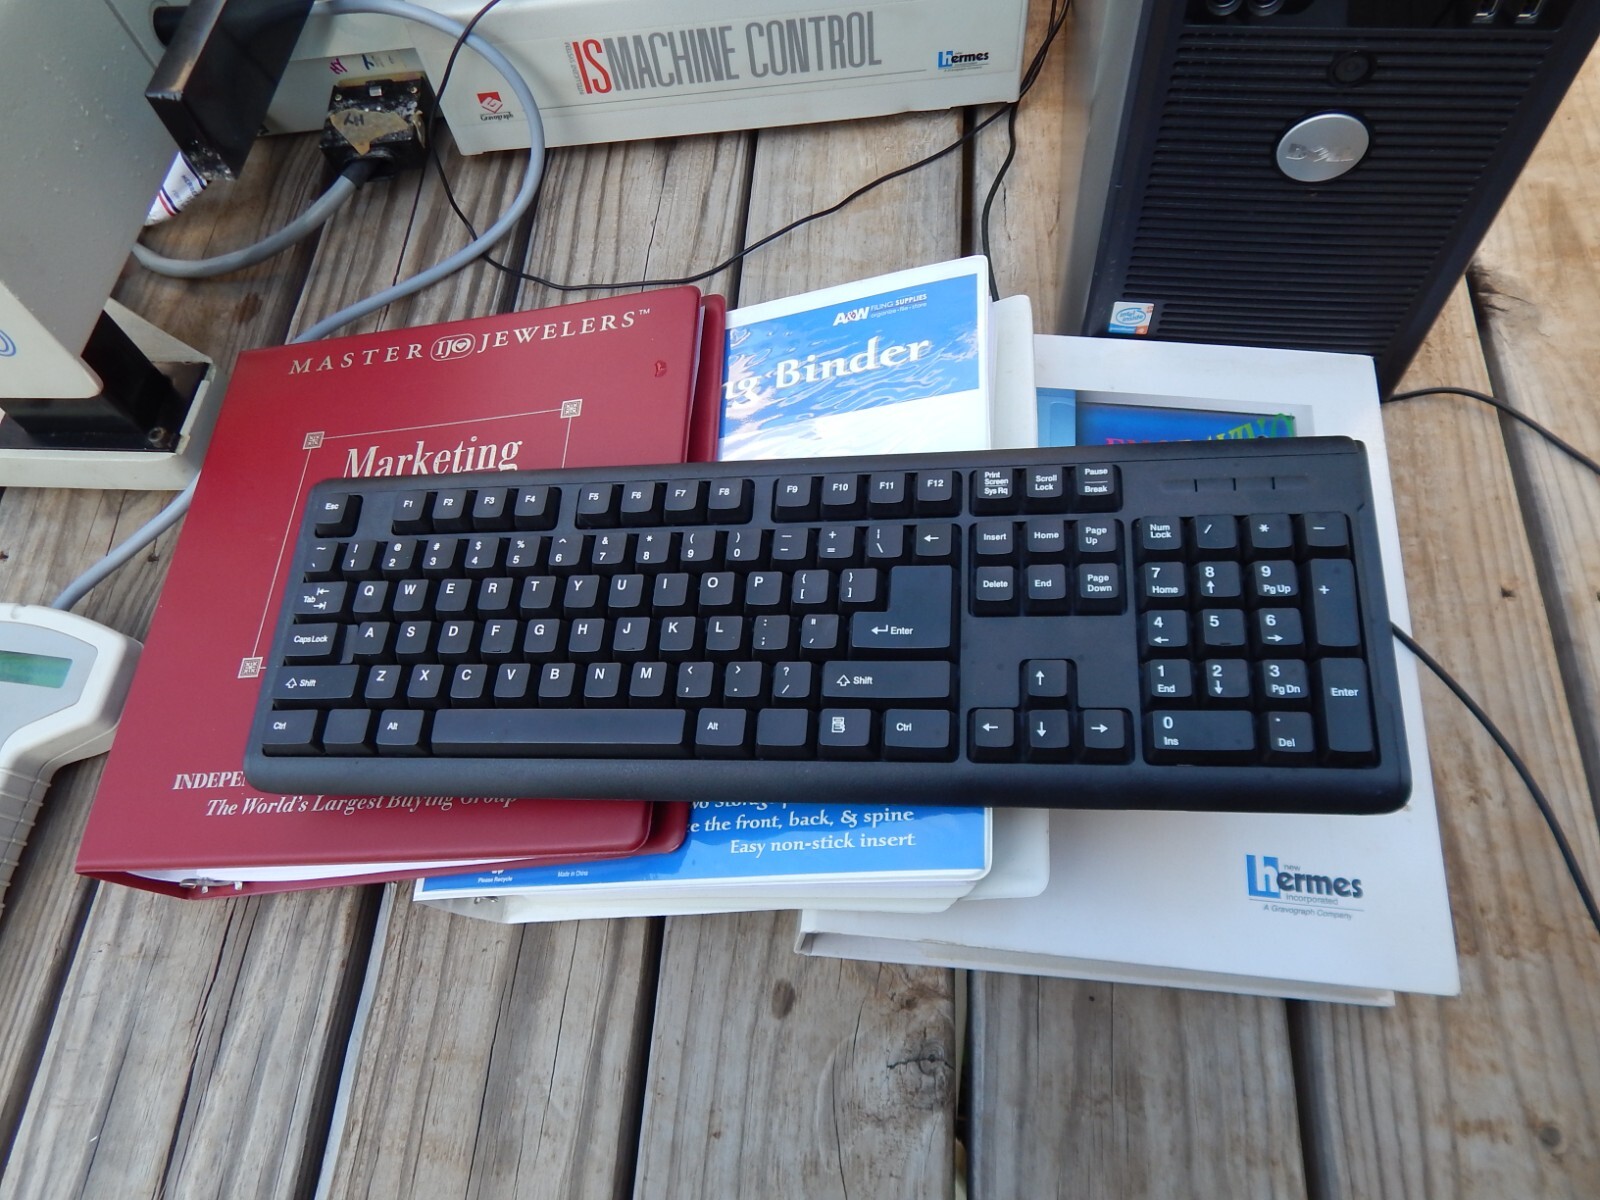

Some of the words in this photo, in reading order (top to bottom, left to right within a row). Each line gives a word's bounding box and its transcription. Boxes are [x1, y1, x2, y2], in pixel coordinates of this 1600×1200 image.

[603, 25, 740, 92] MACHINE
[745, 10, 882, 79] CONTROL
[870, 301, 894, 311] FILING
[895, 293, 928, 306] SUPPLIES
[288, 342, 424, 376] MASTER
[477, 311, 635, 354] JEWELERS
[775, 335, 931, 389] Binder
[343, 435, 523, 479] Marketing
[1084, 468, 1109, 476] Pause
[927, 479, 944, 488] F12
[1035, 474, 1058, 483] Scroll
[786, 485, 799, 494] F9
[832, 483, 849, 492] F10
[879, 481, 894, 490] F11
[1034, 483, 1054, 491] Lock
[1084, 484, 1108, 493] Break
[588, 492, 600, 501] F5
[630, 491, 642, 500] F6
[674, 489, 687, 497] F7
[718, 487, 730, 496] F8
[403, 499, 414, 508] F1
[442, 498, 454, 506] F2
[483, 496, 496, 505] F3
[524, 494, 536, 503] F4
[324, 502, 340, 510] Esc
[1085, 526, 1108, 537] Page
[1149, 523, 1171, 532] Num
[983, 533, 1007, 541] Insert
[1033, 531, 1060, 539] Home
[1150, 530, 1172, 539] Lock
[555, 553, 563, 563] 6
[599, 551, 607, 561] 7
[642, 551, 650, 561] 8
[687, 548, 695, 559] 9
[350, 558, 356, 568] 1
[388, 558, 396, 567] 2
[429, 556, 437, 566] 3
[471, 556, 479, 565] 4
[512, 554, 521, 565] 5
[1151, 567, 1161, 579] 7
[1204, 565, 1215, 578] 8
[1260, 565, 1272, 578] 9
[754, 576, 764, 588] P
[982, 579, 1009, 588] Delete
[1034, 579, 1052, 588] End
[1087, 573, 1110, 584] Page
[363, 584, 375, 596] Q
[404, 584, 417, 595] W
[445, 582, 456, 594] E
[487, 582, 498, 594] R
[530, 580, 540, 592] T
[574, 580, 583, 591] Y
[617, 579, 627, 591] U
[1087, 584, 1113, 592] Down
[1151, 585, 1179, 594] Home
[1153, 616, 1164, 628] 4
[1209, 615, 1220, 628] 5
[1265, 614, 1277, 627] 6
[364, 626, 374, 638] A
[406, 625, 416, 638] S
[448, 625, 459, 637] D
[490, 624, 501, 636] F
[533, 623, 545, 636] G
[577, 623, 588, 635] H
[622, 622, 632, 634] J
[668, 621, 679, 633] K
[715, 621, 724, 633] L
[890, 626, 914, 635] Enter
[311, 635, 328, 643] Lock
[375, 670, 387, 682] Z
[419, 669, 430, 681] X
[461, 668, 472, 681] C
[507, 668, 517, 681] V
[549, 668, 560, 680] B
[594, 667, 606, 680] N
[640, 667, 653, 679] M
[1157, 664, 1165, 677] 1
[1212, 664, 1223, 677] 2
[1269, 664, 1281, 678] 3
[299, 678, 317, 687] Shift
[852, 675, 873, 685] Shift
[1157, 683, 1176, 693] End
[1330, 687, 1359, 697] Enter
[272, 721, 287, 730] Ctrl
[386, 721, 399, 731] Alt
[706, 721, 719, 731] Alt
[896, 722, 912, 732] Ctrl
[1163, 736, 1180, 746] Ins
[1277, 737, 1296, 748] Del
[205, 799, 238, 817] The
[241, 795, 309, 815] World's
[311, 794, 384, 816] Largest
[704, 816, 731, 832] the
[735, 813, 782, 830] front,
[789, 807, 834, 827] back,
[840, 810, 858, 828] &
[863, 807, 915, 829] spine
[730, 839, 766, 858] Easy
[770, 832, 854, 852] non-stick
[859, 832, 916, 848] insert
[1285, 894, 1339, 906] incorporated
[1271, 905, 1315, 917] Gravograph
[1317, 908, 1352, 921] Company
